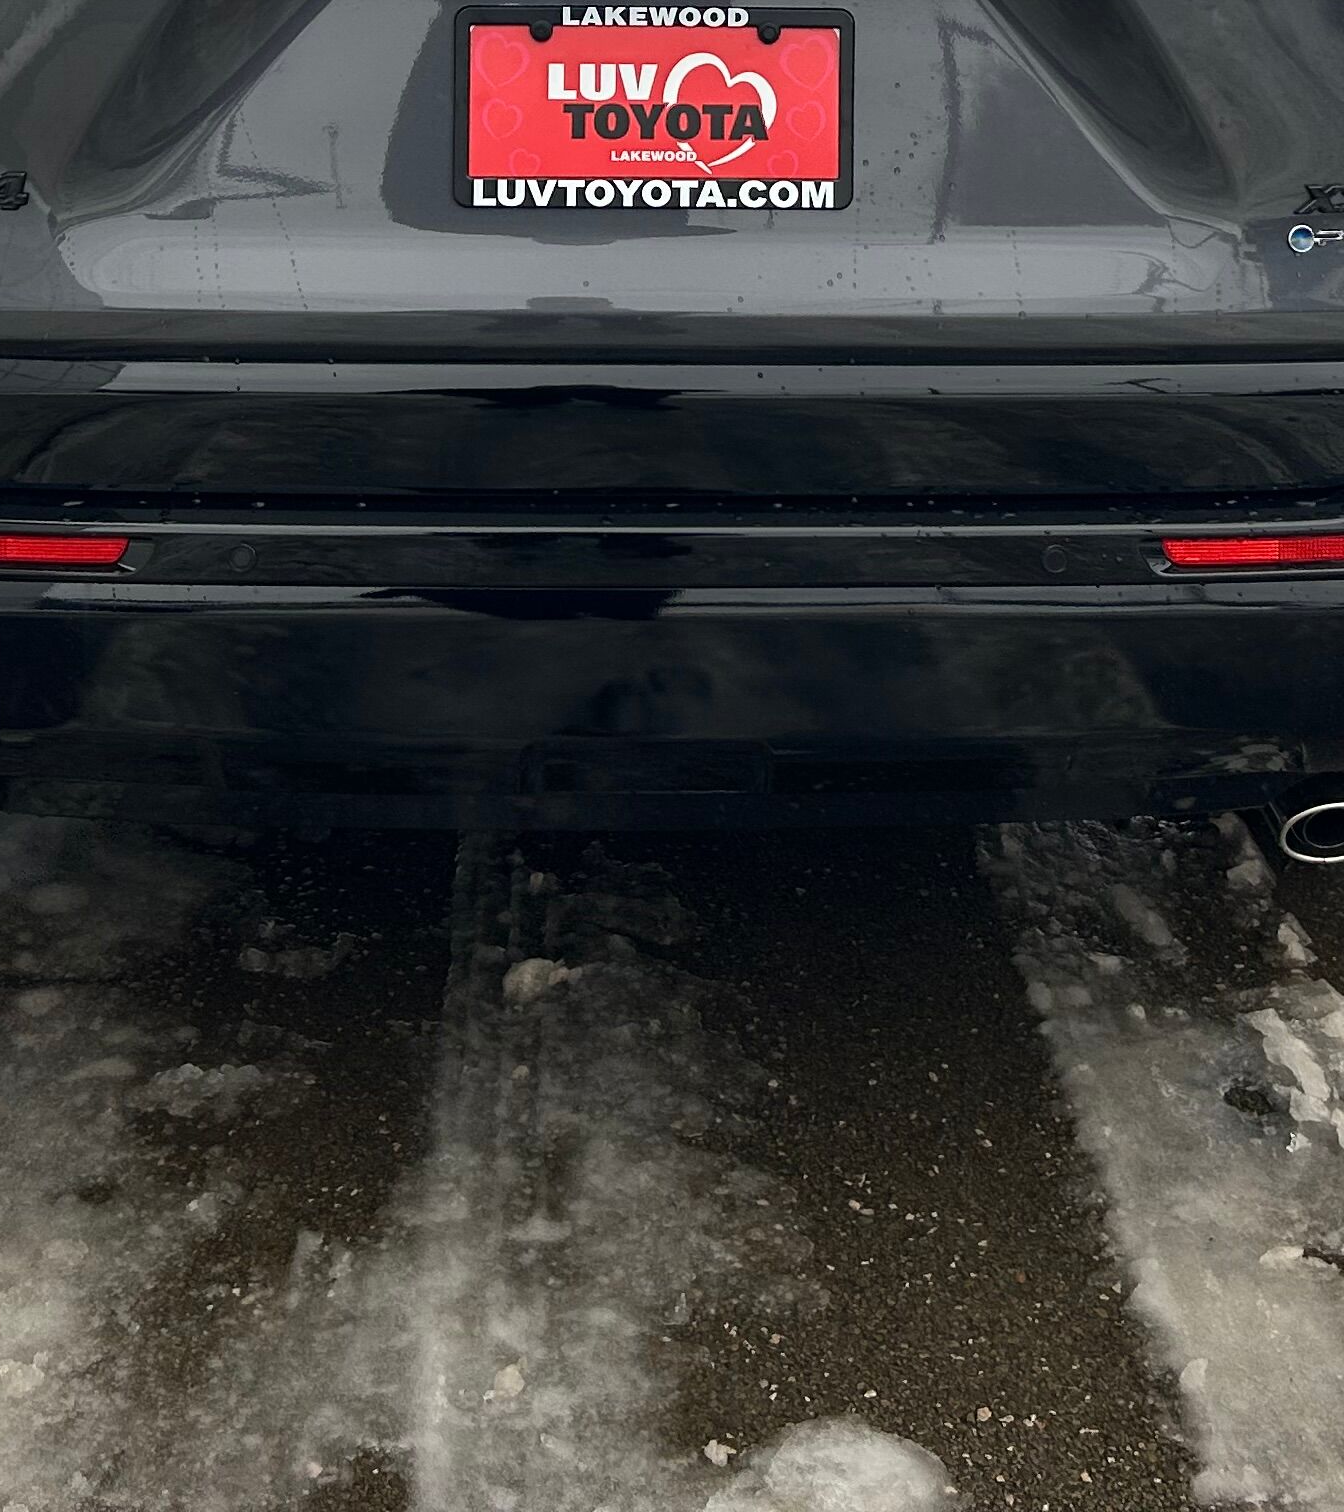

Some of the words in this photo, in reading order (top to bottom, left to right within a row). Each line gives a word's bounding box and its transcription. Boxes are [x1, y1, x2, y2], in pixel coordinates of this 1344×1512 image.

[562, 6, 749, 27] LAKEWOOD
[547, 63, 658, 101] LUV
[563, 103, 769, 141] TOYOTA
[610, 150, 698, 162] LAKEWOOD
[472, 179, 835, 208] LUVTOYOTA.COM
